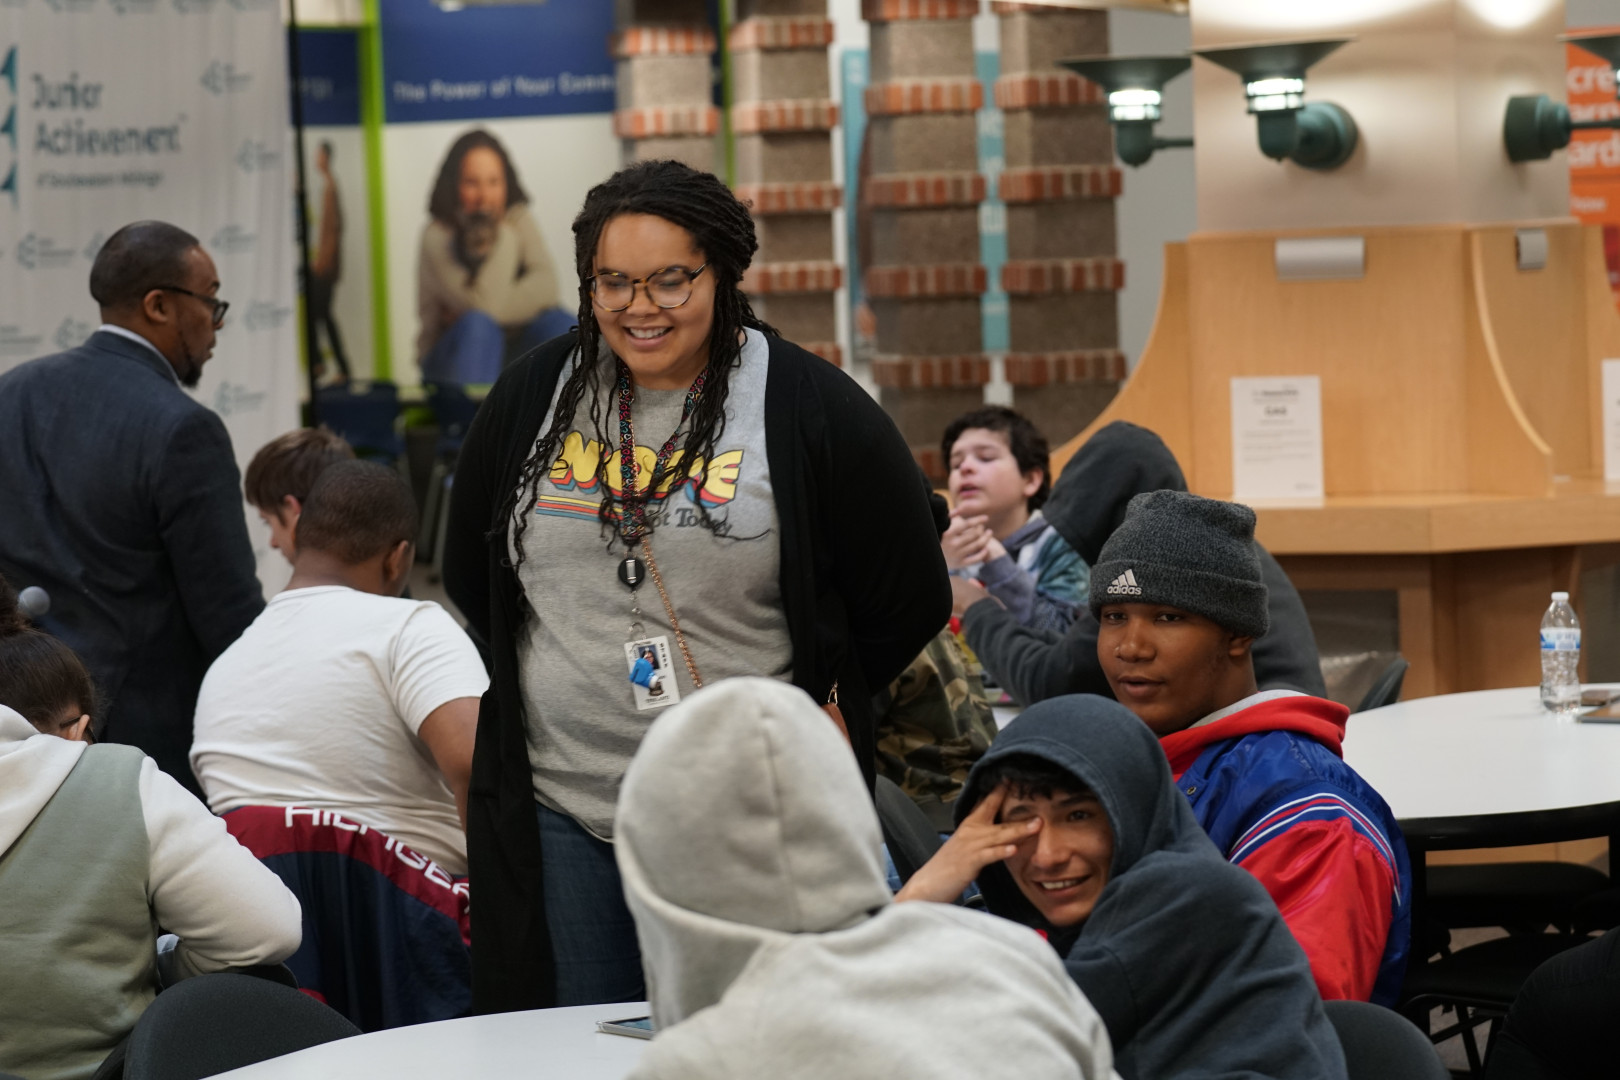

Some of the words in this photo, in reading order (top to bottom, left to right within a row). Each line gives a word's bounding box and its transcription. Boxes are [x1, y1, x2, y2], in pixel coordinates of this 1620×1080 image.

[394, 80, 426, 103] The
[429, 78, 486, 102] Power
[490, 75, 511, 99] of
[514, 74, 555, 97] Your
[1107, 585, 1142, 595] adidas
